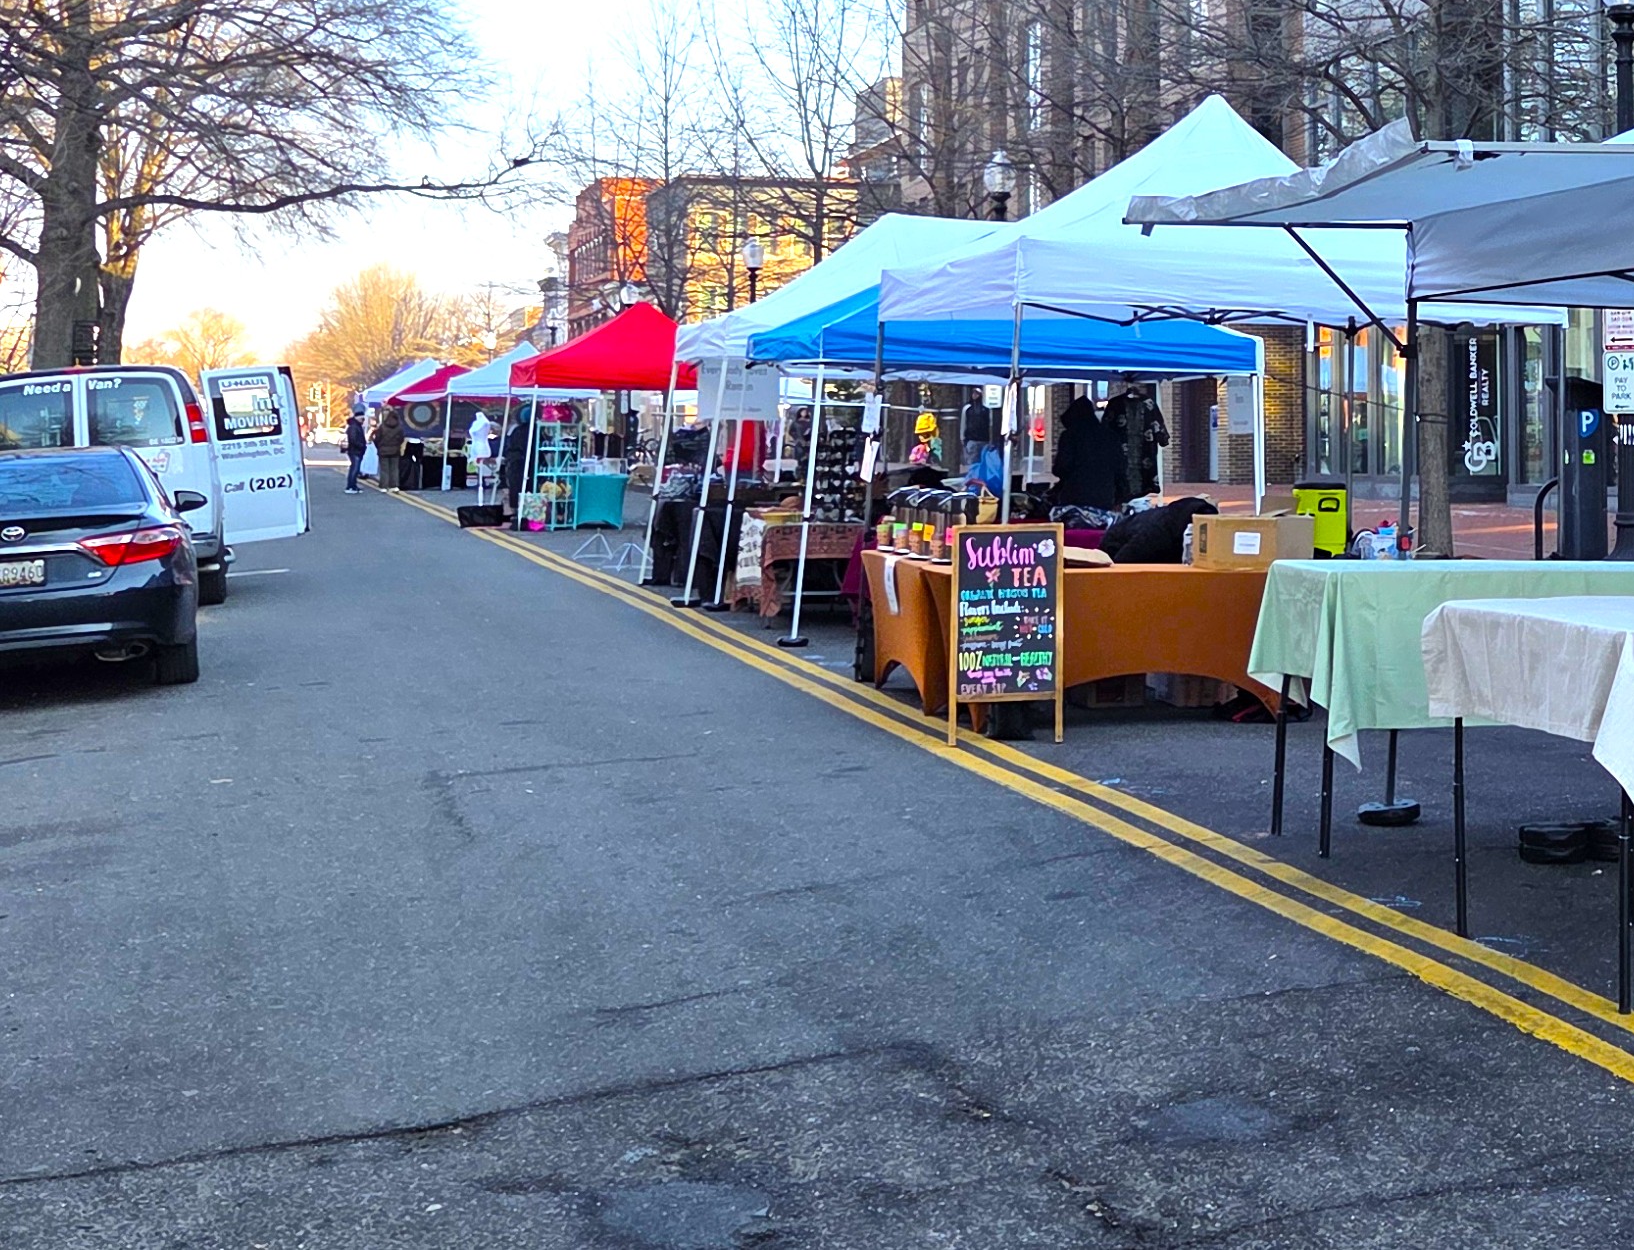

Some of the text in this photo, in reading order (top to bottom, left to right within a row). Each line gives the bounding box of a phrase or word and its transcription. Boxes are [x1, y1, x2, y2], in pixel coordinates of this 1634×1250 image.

[1468, 337, 1478, 380] BANKER
[23, 379, 122, 396] Need a Van?
[1481, 368, 1490, 406] REALTY
[1614, 376, 1628, 384] PAY
[1617, 385, 1627, 393] TO
[1611, 393, 1632, 401] PARK
[224, 414, 279, 431] MOVING
[1581, 411, 1594, 433] P
[224, 473, 293, 493] Call (202)
[1011, 566, 1048, 587] TEA
[959, 651, 983, 671] 100%
